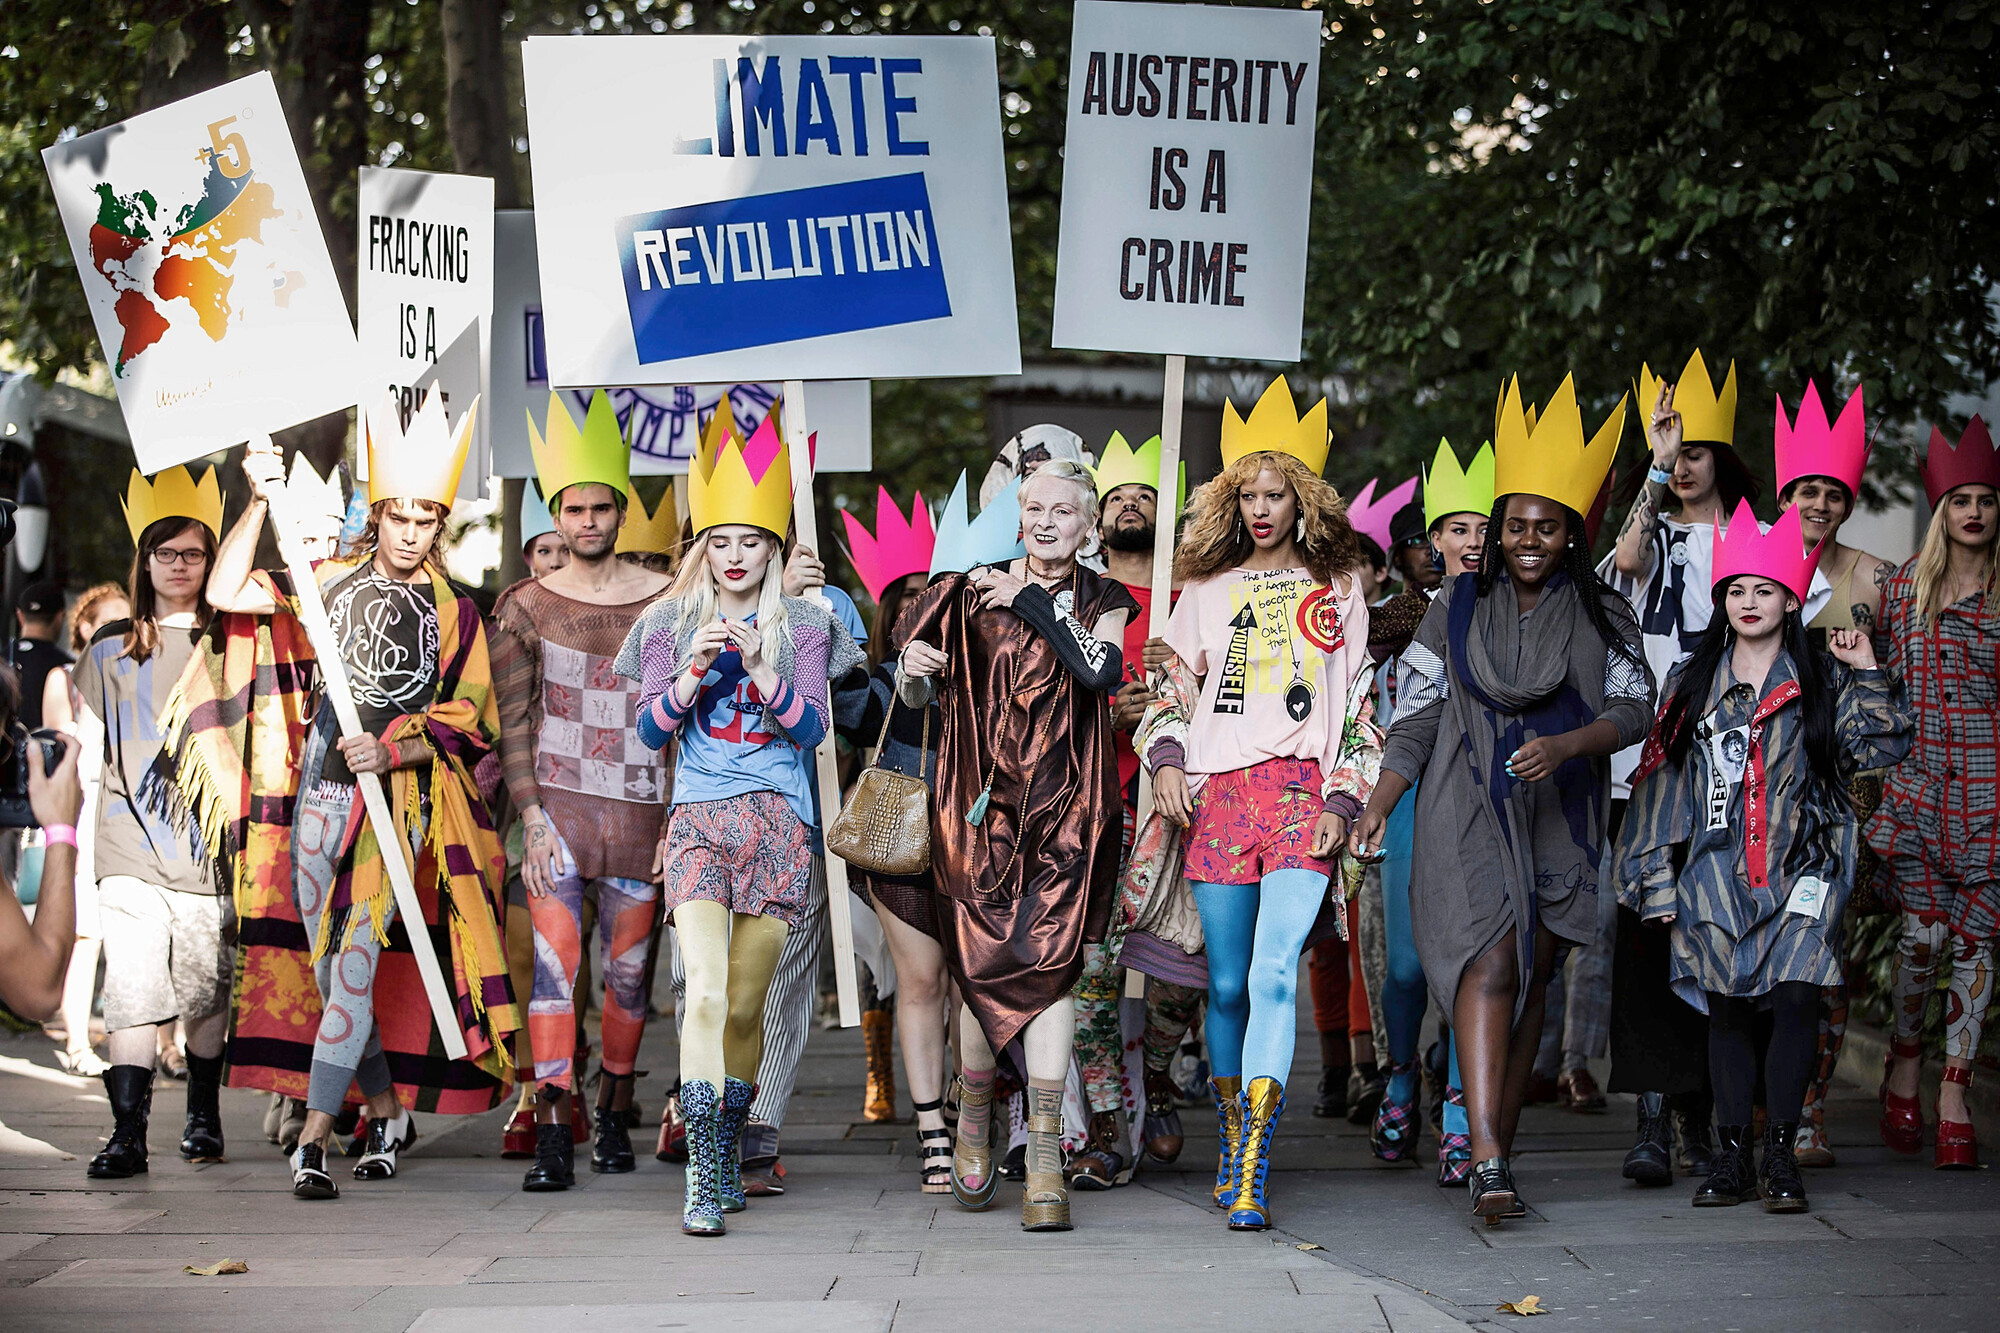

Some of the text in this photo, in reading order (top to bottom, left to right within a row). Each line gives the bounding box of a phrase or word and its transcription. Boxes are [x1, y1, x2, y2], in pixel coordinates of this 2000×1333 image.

[1081, 51, 1308, 125] AUSTERITY
[1149, 147, 1226, 214] IS A
[369, 214, 469, 284] FRACKING
[633, 209, 931, 291] REVOLUTION
[1119, 237, 1248, 307] CRIME
[400, 302, 438, 364] IS A
[1242, 571, 1259, 581] the
[1253, 584, 1262, 593] is
[1265, 580, 1296, 593] happy
[1300, 577, 1312, 587] to
[1258, 591, 1298, 609] become
[1311, 607, 1341, 623] SAVE
[1216, 628, 1249, 714] YOURSELF
[1786, 686, 1798, 697] uk
